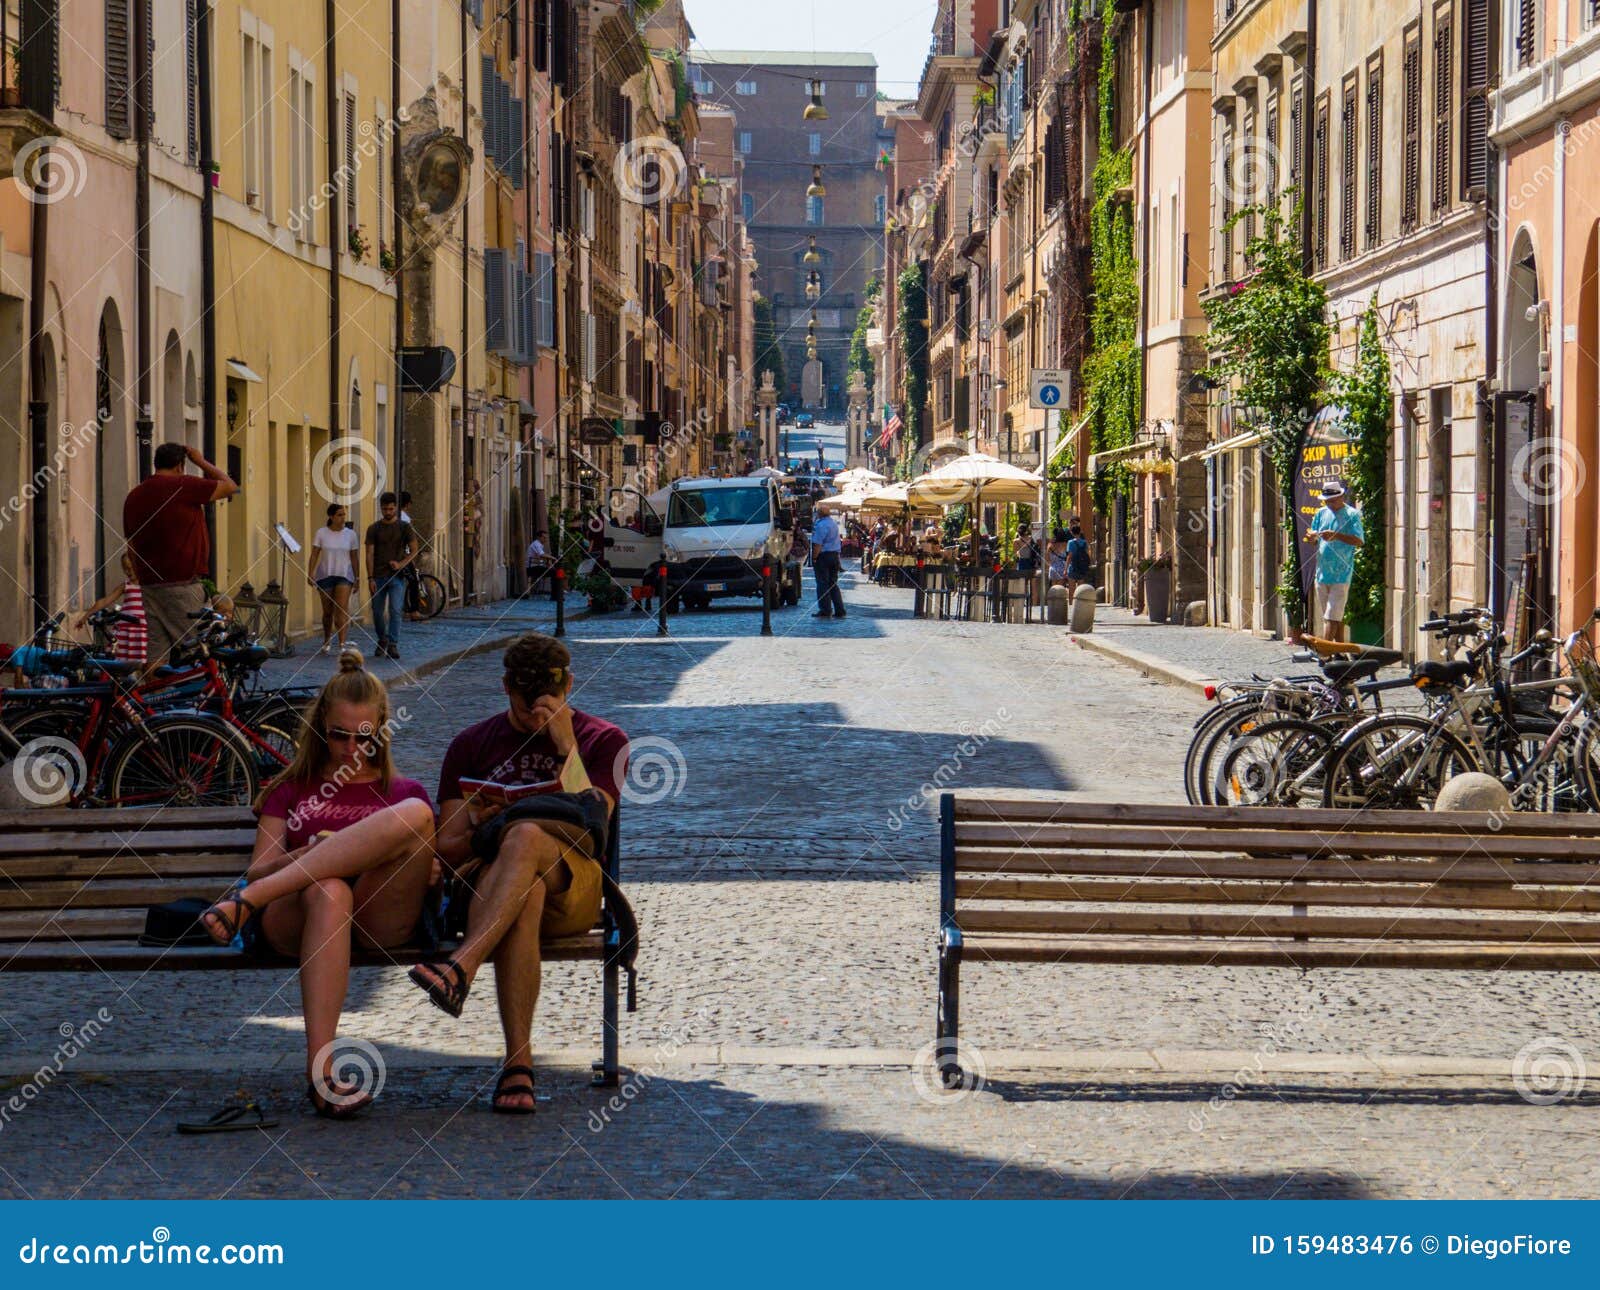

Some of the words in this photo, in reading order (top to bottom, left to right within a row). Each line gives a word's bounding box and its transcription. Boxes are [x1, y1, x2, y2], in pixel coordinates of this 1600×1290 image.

[1303, 446, 1327, 462] SKIP
[1328, 443, 1348, 459] THE
[1301, 463, 1354, 478] GOLDE
